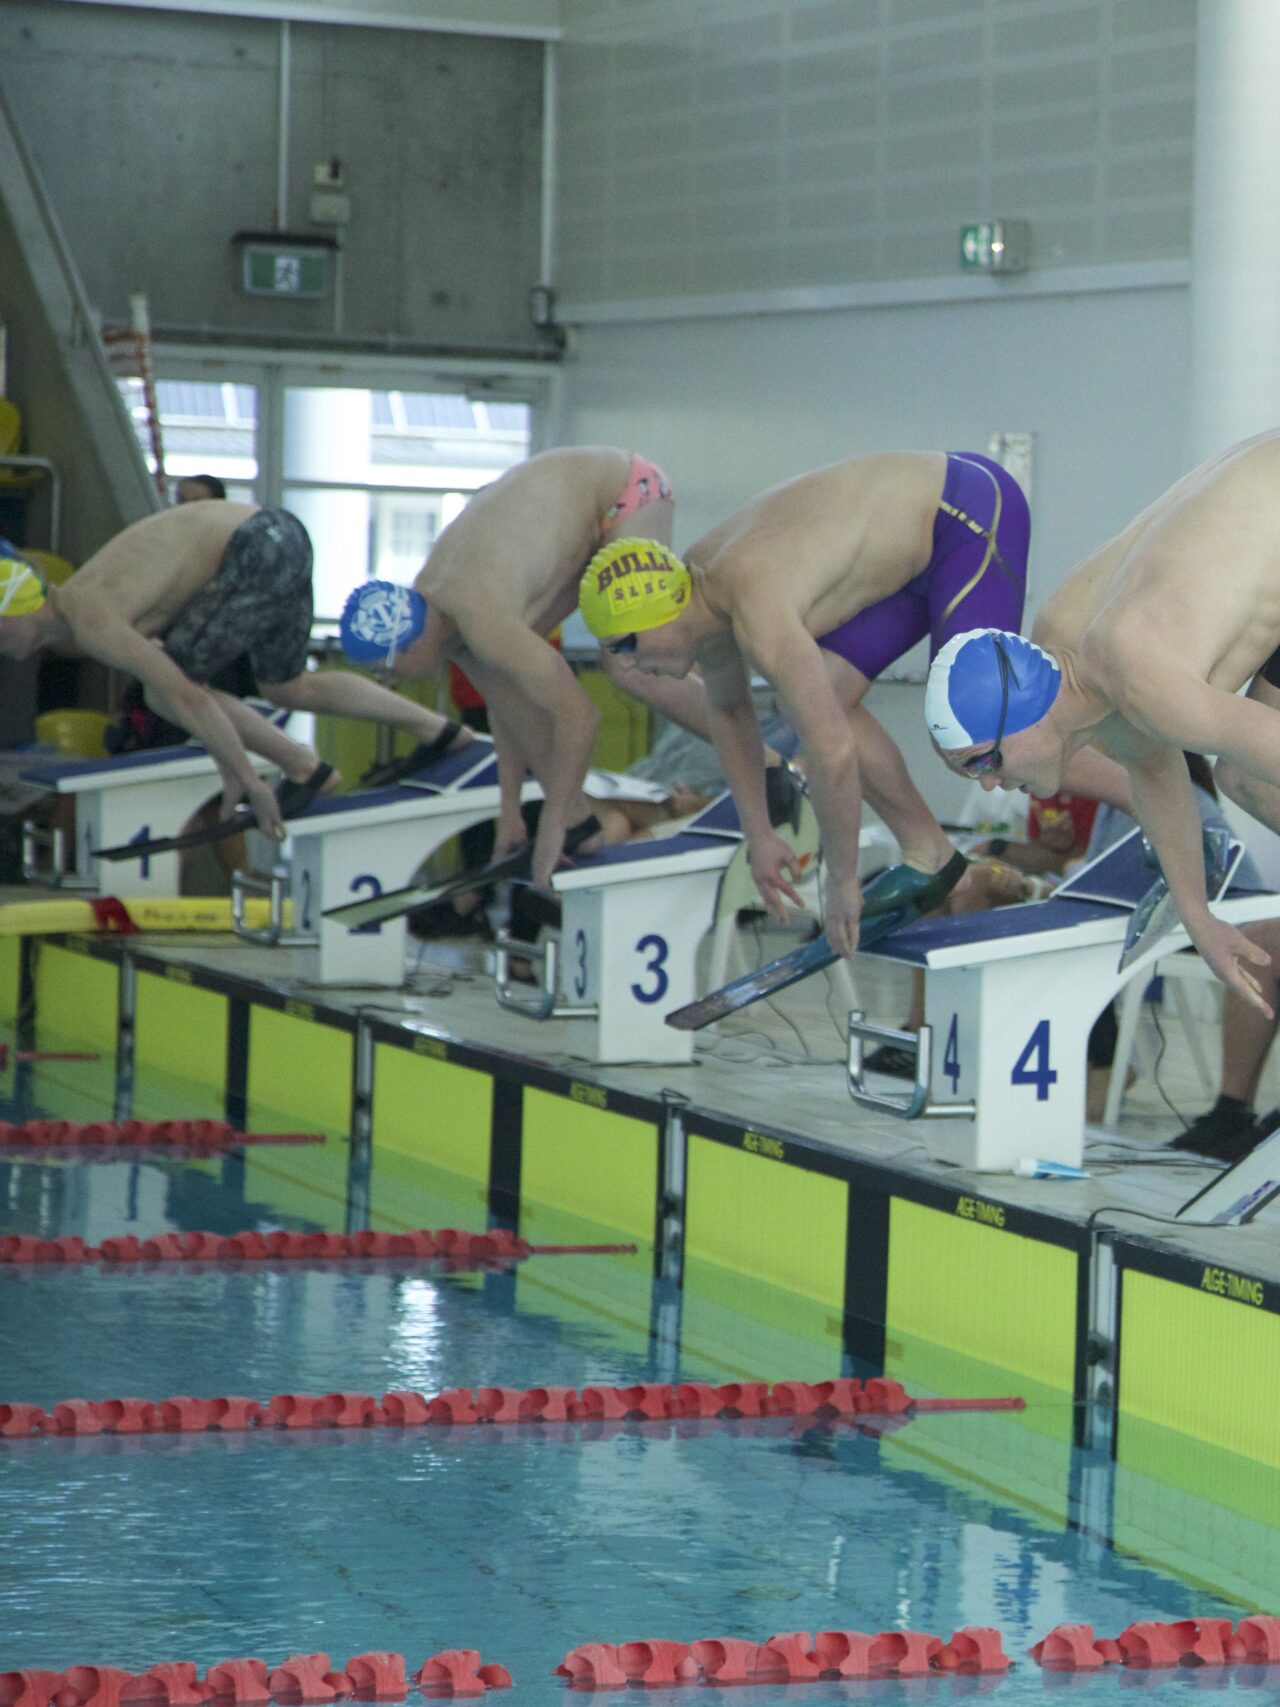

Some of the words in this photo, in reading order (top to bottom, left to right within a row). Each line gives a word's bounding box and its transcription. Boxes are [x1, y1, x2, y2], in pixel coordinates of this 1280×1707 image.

[128, 825, 149, 879] 1
[349, 874, 382, 934] 2
[575, 929, 587, 999] 3
[631, 934, 668, 1004] 3
[943, 1012, 961, 1095] 4
[1010, 1019, 1057, 1101] 4
